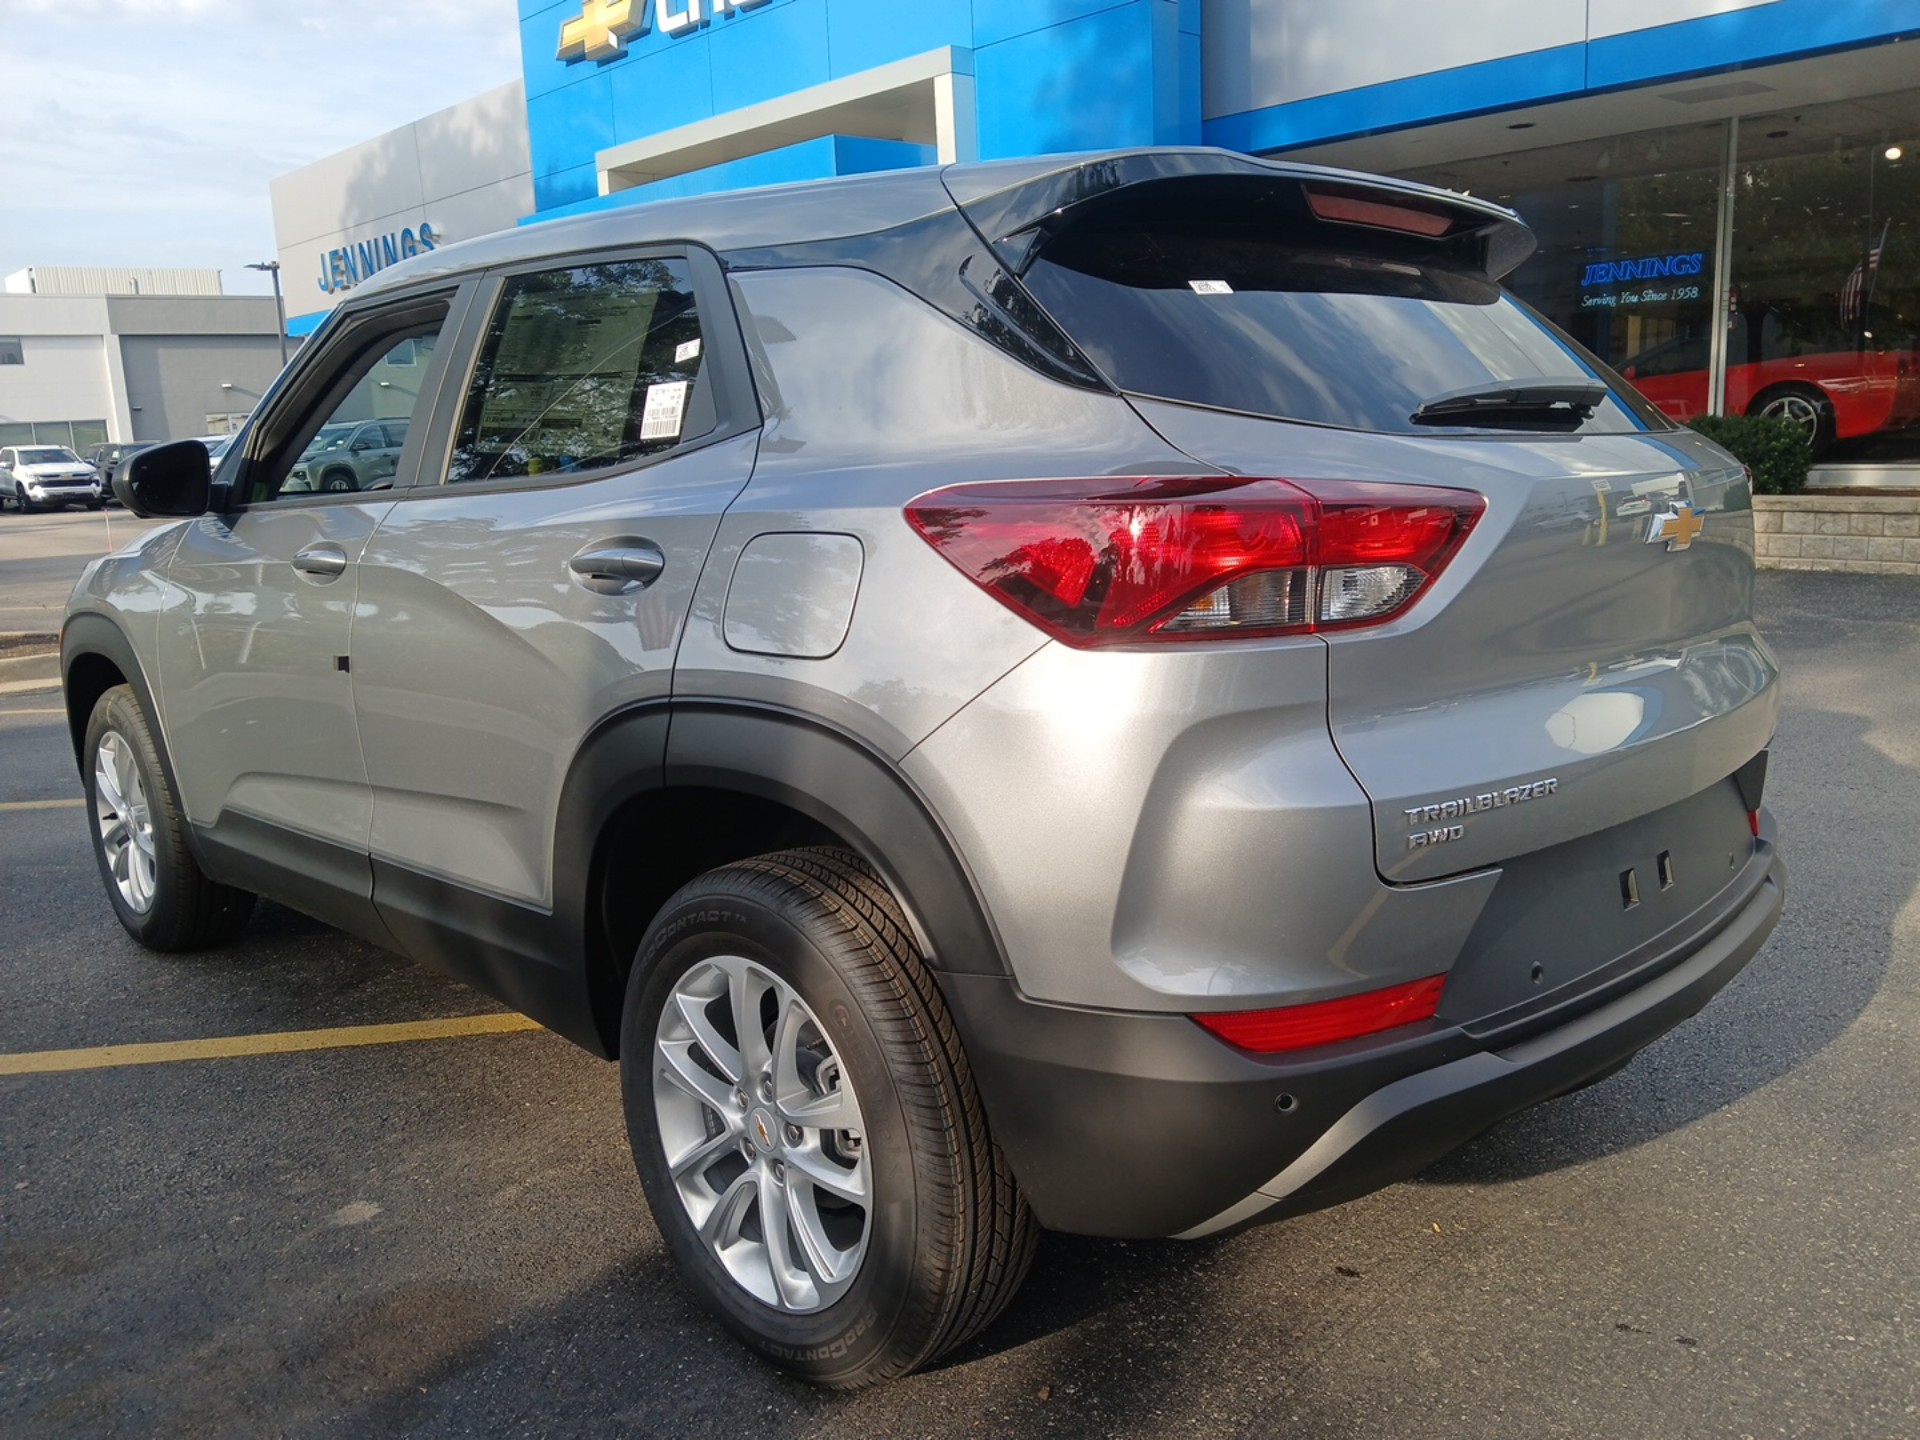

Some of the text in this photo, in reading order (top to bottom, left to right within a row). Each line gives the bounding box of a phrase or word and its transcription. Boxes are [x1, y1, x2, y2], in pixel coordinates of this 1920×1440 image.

[317, 222, 436, 292] JENNINGS
[1581, 252, 1703, 287] JENNINGS
[1582, 286, 1698, 307] Serving You Since 1958
[1404, 778, 1558, 826] TRAILBLAZER
[1408, 824, 1464, 849] AWD
